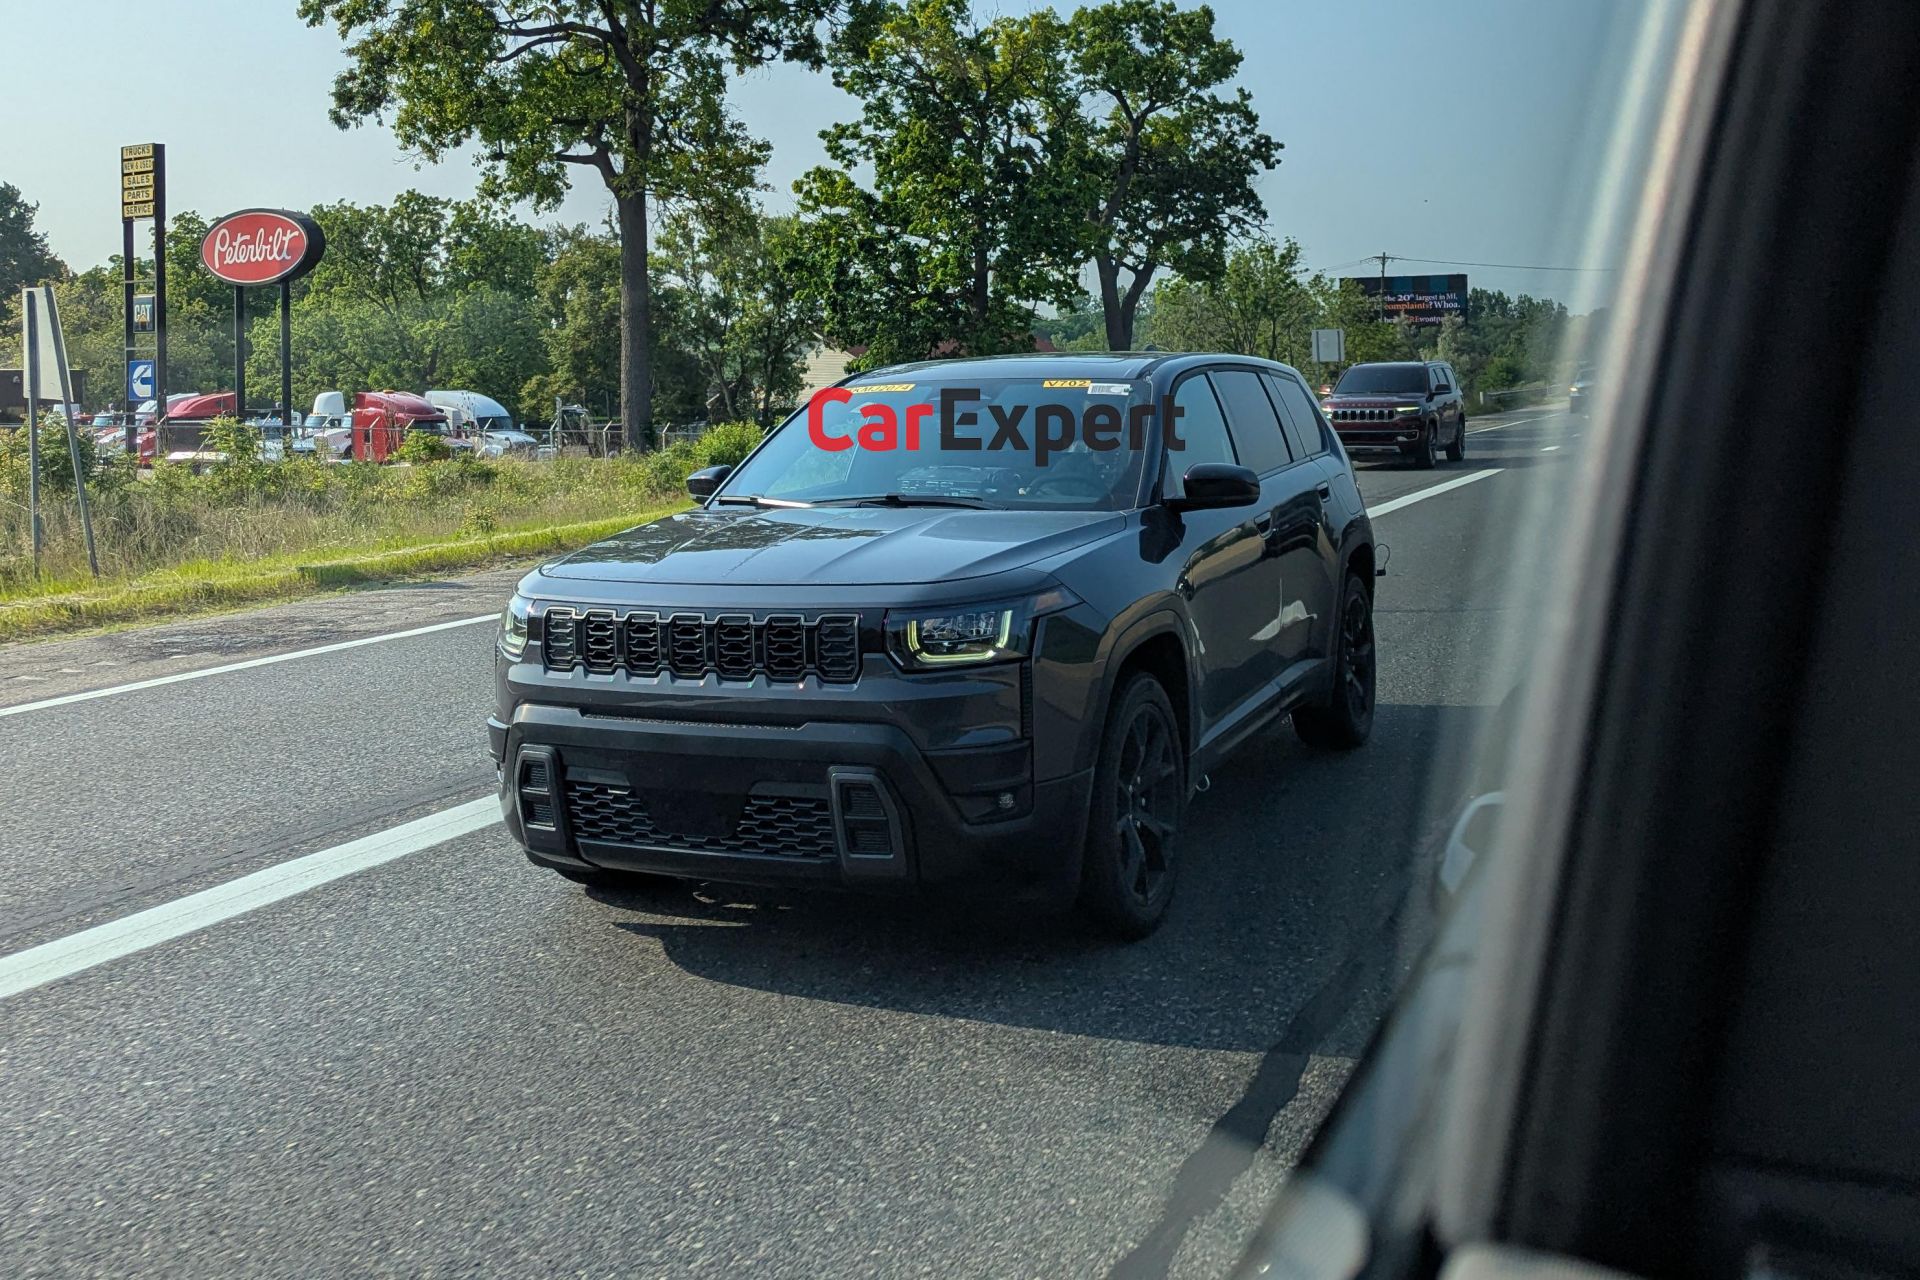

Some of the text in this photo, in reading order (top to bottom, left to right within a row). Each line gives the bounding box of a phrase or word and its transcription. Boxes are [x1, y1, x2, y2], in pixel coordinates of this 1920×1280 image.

[124, 145, 151, 157] TRUCKS
[123, 161, 134, 171] NEW
[139, 159, 152, 170] USED
[126, 174, 150, 186] SALES
[126, 189, 150, 200] PARTS
[125, 204, 152, 215] SERVICE
[213, 227, 299, 270] Peterbilt
[1416, 292, 1438, 303] largest
[134, 304, 152, 323] CAT
